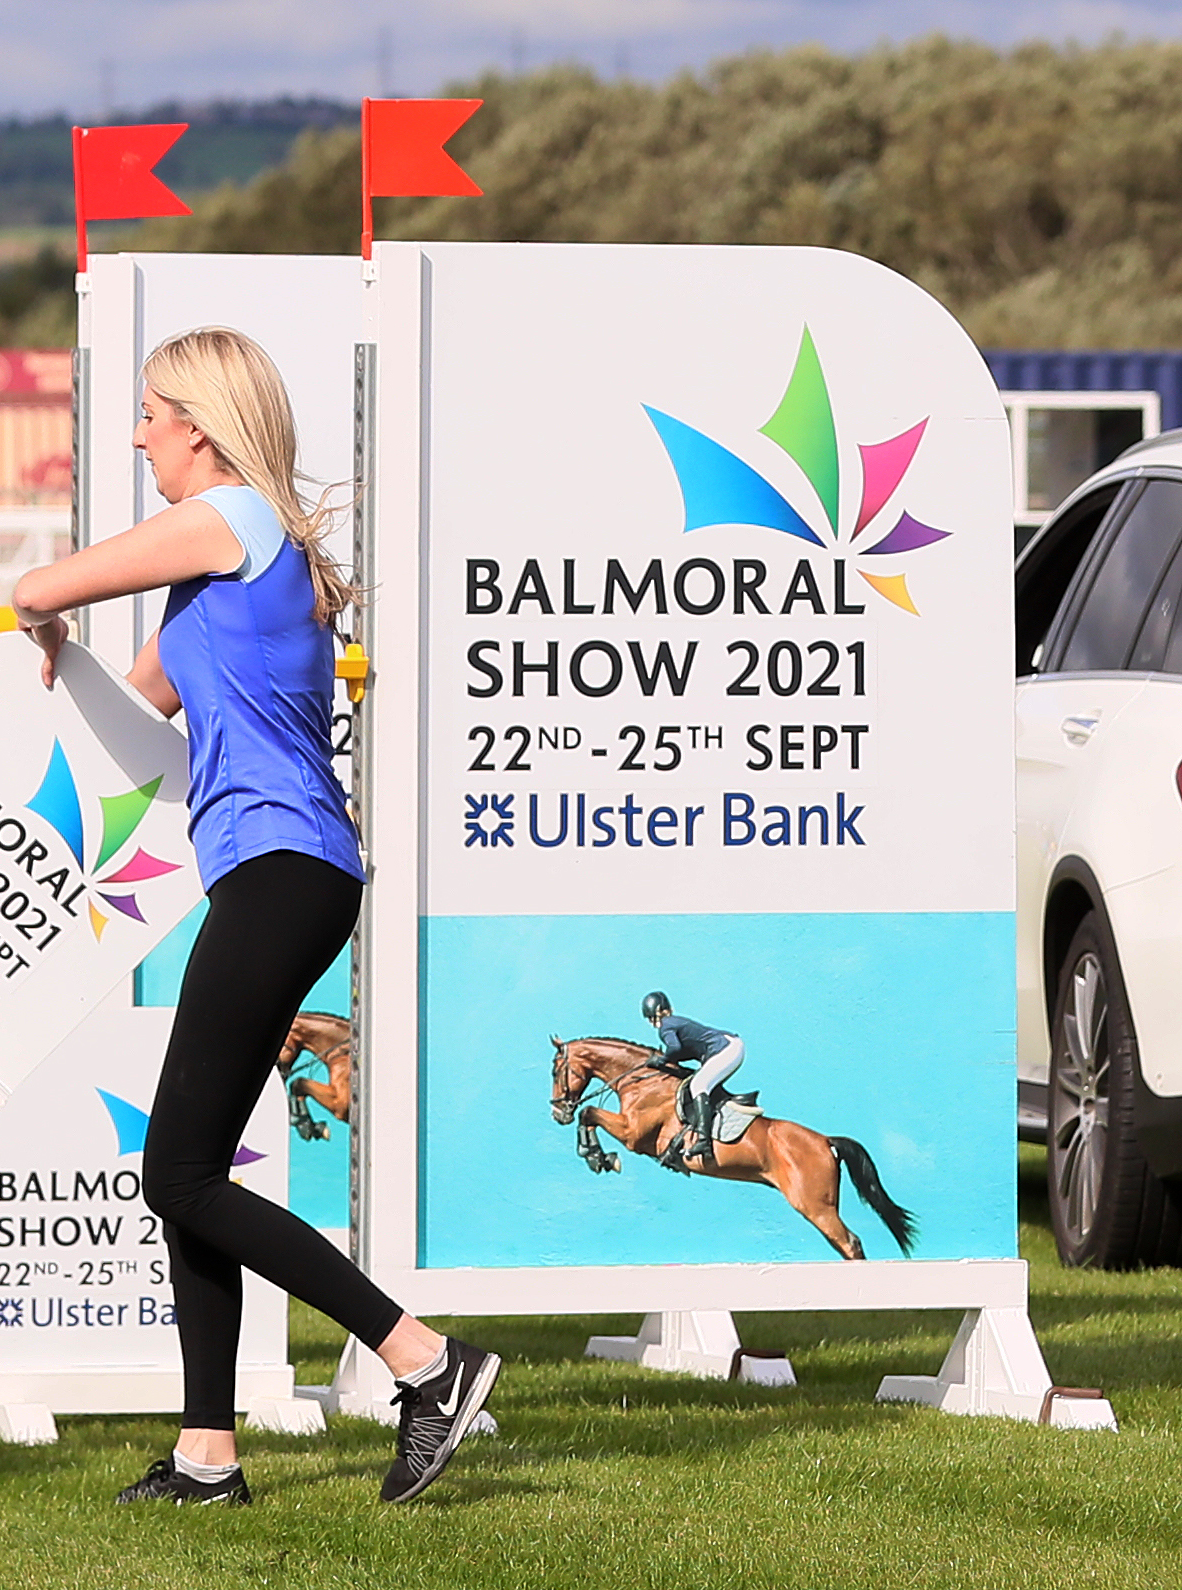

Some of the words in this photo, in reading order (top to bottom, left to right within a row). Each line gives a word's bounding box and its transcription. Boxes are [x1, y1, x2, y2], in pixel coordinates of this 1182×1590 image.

[464, 557, 867, 616] BALMORAL
[465, 640, 699, 698] SHOW
[726, 640, 867, 697] 2021
[746, 723, 869, 771] SEPT
[529, 792, 705, 848] Ulster
[723, 791, 867, 847] Bank
[31, 1297, 129, 1327] Ulster
[138, 1296, 178, 1326] Ba
